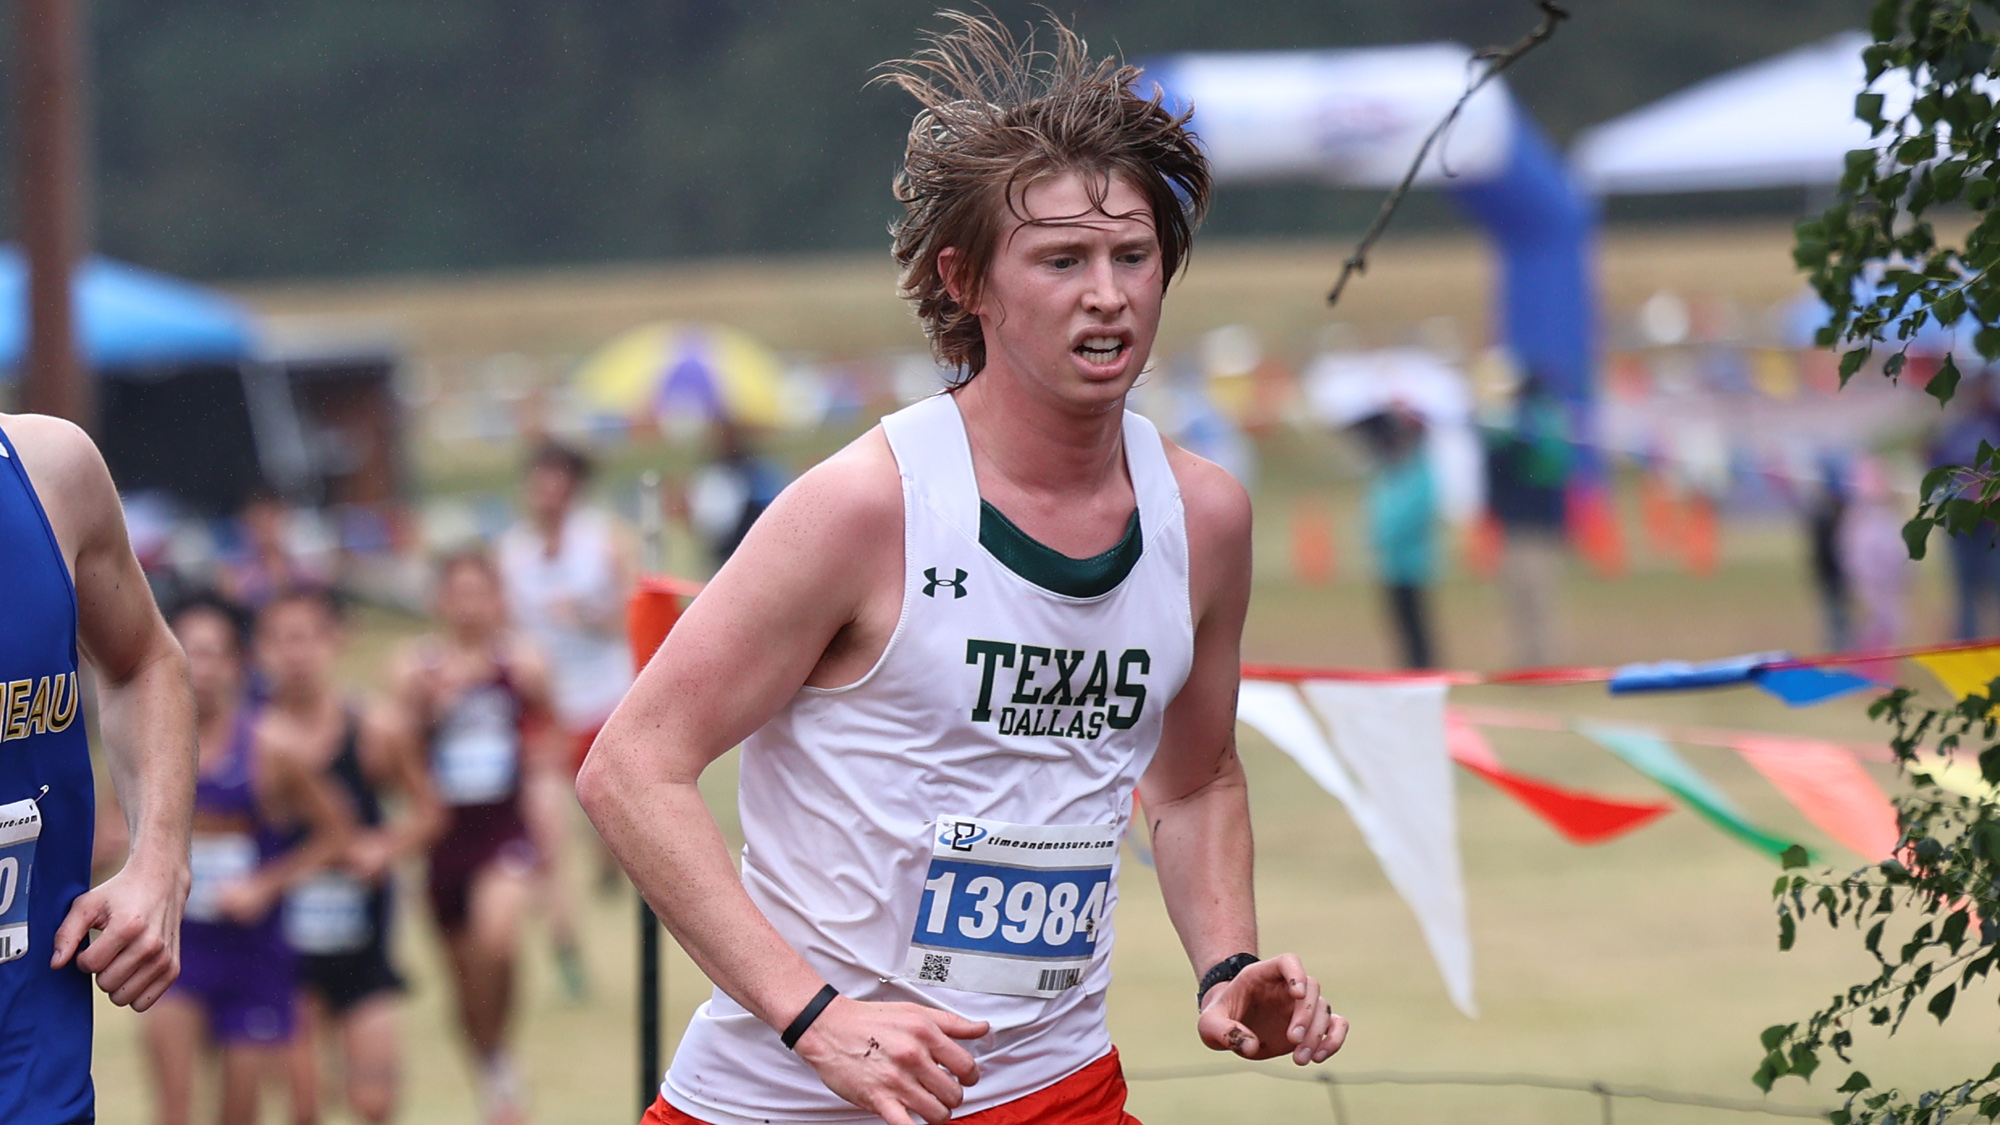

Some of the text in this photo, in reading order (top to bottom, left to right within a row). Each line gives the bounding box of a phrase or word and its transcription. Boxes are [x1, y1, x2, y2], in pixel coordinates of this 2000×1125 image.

[0, 671, 78, 743] EAU
[965, 638, 1151, 730] TEXAS
[998, 707, 1105, 740] DALLAS
[988, 837, 1114, 850] timeandmeasure.com
[924, 871, 1108, 946] 13984
